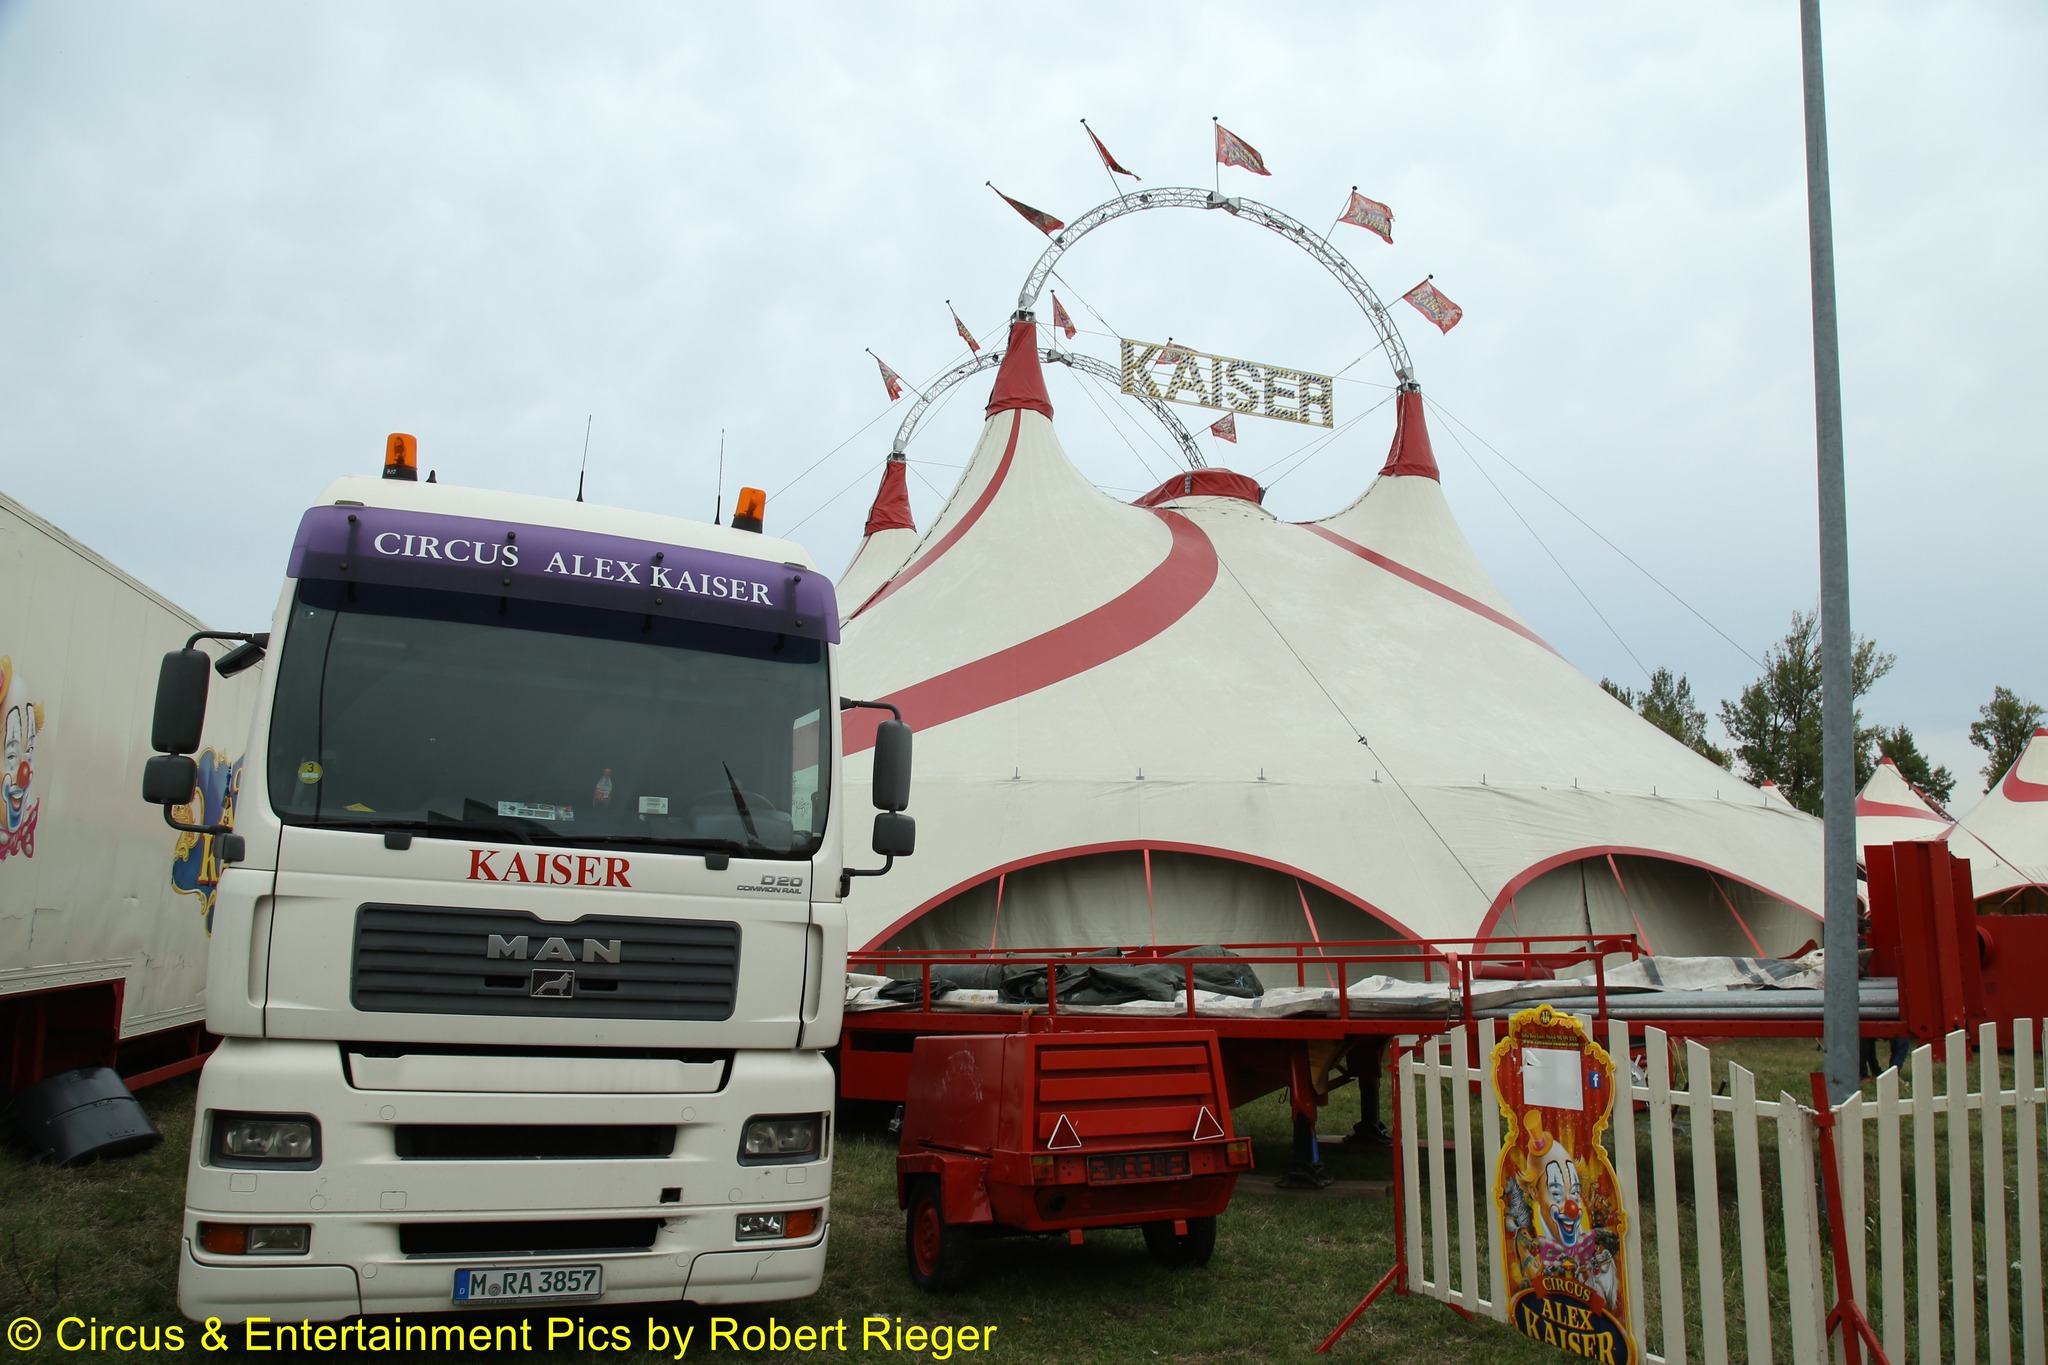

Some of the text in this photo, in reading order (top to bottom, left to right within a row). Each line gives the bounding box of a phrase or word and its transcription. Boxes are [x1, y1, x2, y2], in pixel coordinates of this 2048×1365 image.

[1122, 339, 1333, 427] KAISER
[373, 531, 774, 607] CIRCUS ALEX KAISER
[307, 762, 314, 773] 3
[466, 849, 632, 888] KAISER
[737, 885, 781, 893] COMMON
[486, 934, 622, 964] MAN
[538, 1269, 597, 1293] 3857
[1542, 1277, 1592, 1302] CIRCUS
[1541, 1297, 1595, 1331] ALEX
[1522, 1303, 1615, 1365] KAISER
